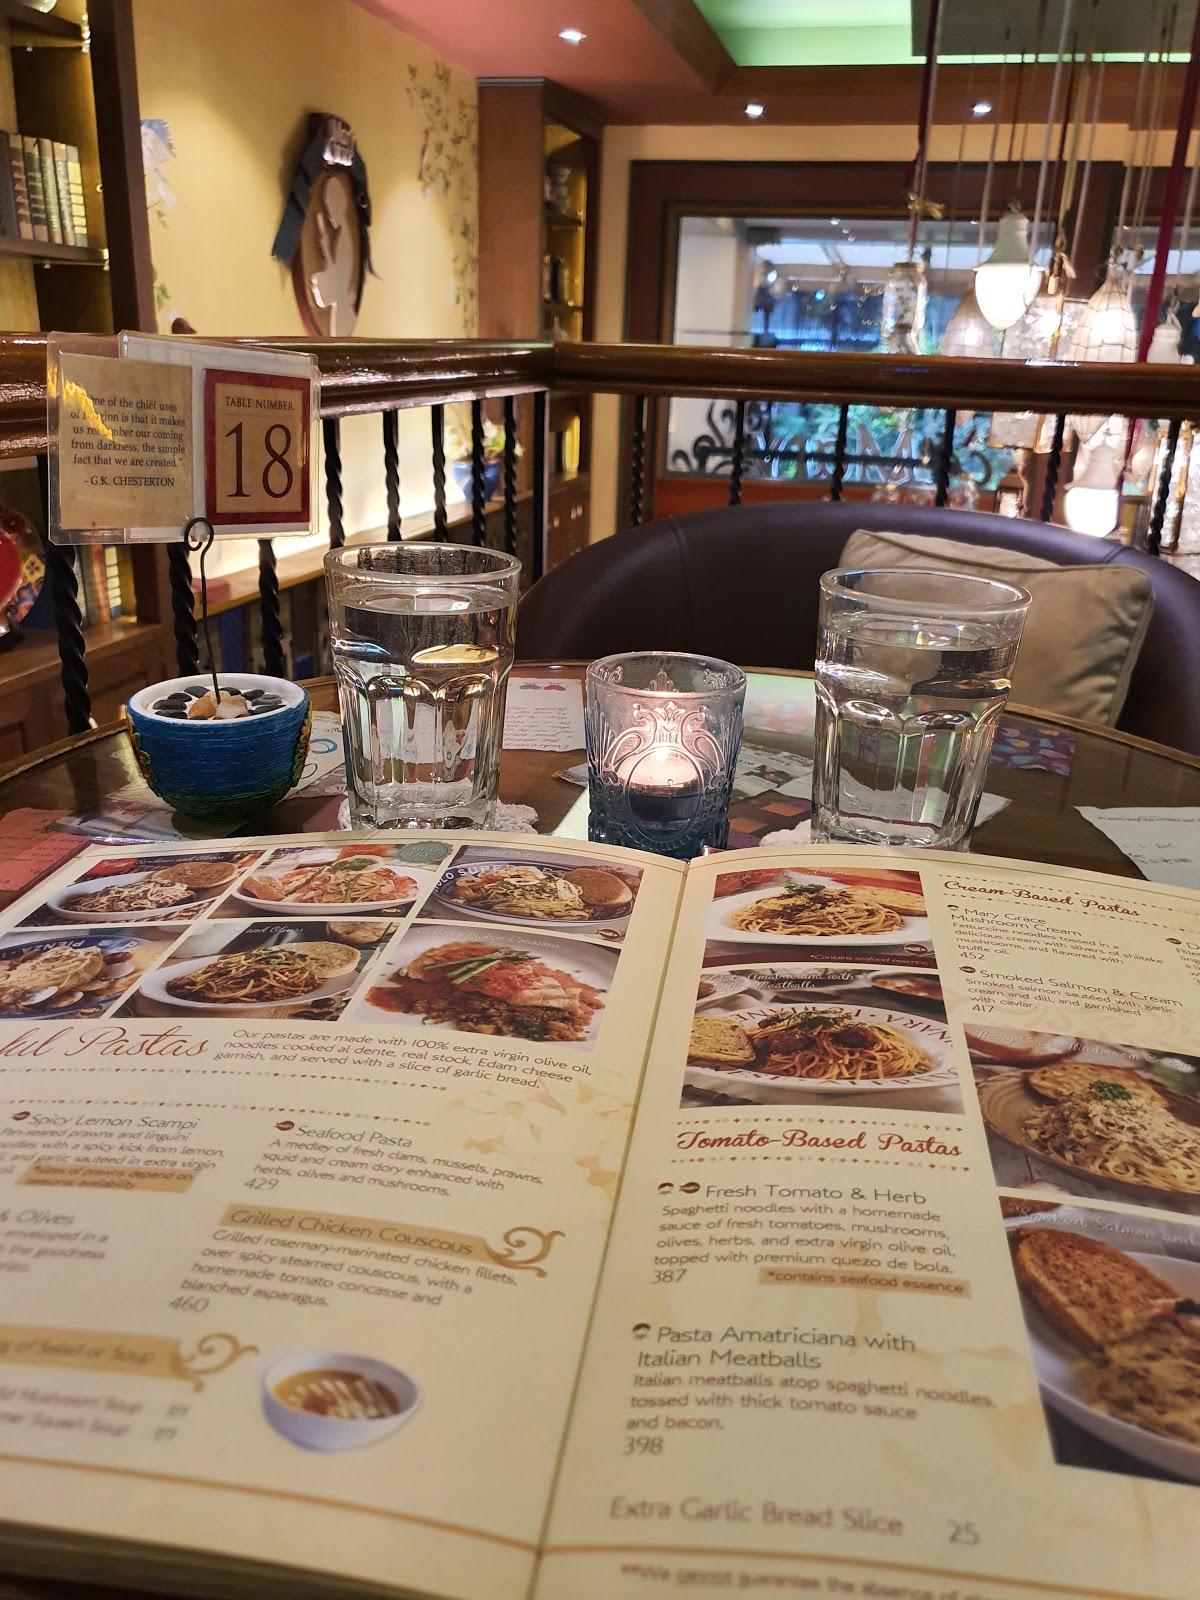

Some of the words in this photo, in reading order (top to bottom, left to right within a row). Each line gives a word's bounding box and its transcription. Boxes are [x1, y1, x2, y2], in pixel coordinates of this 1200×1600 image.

[108, 396, 117, 406] of
[119, 397, 133, 408] the
[136, 399, 156, 410] chief
[225, 396, 252, 409] TABLE
[255, 399, 293, 411] NUMBER
[121, 415, 129, 423] is
[131, 414, 148, 424] that
[151, 415, 157, 425] it
[159, 416, 186, 427] makes
[73, 426, 84, 434] us
[135, 429, 151, 438] our
[153, 430, 184, 443] coming
[71, 438, 94, 450] from
[97, 440, 140, 453] darkness,
[142, 442, 155, 453] the
[158, 444, 185, 456] simple
[73, 454, 91, 465] fact
[94, 454, 113, 465] that
[114, 457, 127, 466] we
[130, 457, 145, 467] are
[225, 421, 294, 499] 18
[112, 475, 175, 487] CHESTERTON
[944, 880, 1074, 905] Cream-Based
[1079, 898, 1141, 916] Pastas
[951, 914, 1029, 930] Mushroom
[1033, 923, 1082, 937] Cream
[964, 908, 999, 919] Mary
[1004, 913, 1047, 925] Grace
[960, 951, 985, 961] 452
[965, 978, 1014, 989] Smoked
[1017, 985, 1061, 996] salmon
[1115, 999, 1141, 1008] with
[979, 969, 1043, 985] Smoked
[1048, 978, 1107, 994] Salmon
[1111, 988, 1124, 997] &
[1129, 991, 1184, 1008] Cream
[972, 1004, 995, 1013] 417
[64, 1025, 209, 1056] Pastas
[233, 1029, 260, 1039] Our
[262, 1032, 305, 1041] pastas
[334, 1034, 373, 1044] made
[377, 1035, 407, 1047] with
[411, 1039, 450, 1051] 100%
[452, 1044, 488, 1056] extra
[492, 1049, 530, 1063] virgin
[534, 1057, 568, 1070] olive
[223, 1040, 279, 1051] noodles
[282, 1042, 336, 1054] cooked
[337, 1045, 351, 1054] al
[353, 1046, 397, 1058] dente,
[401, 1051, 429, 1061] real
[478, 1057, 517, 1072] Edam
[522, 1066, 573, 1082] cheese
[270, 1053, 297, 1062] and
[300, 1055, 349, 1065] served
[352, 1057, 383, 1067] with
[398, 1060, 432, 1072] slice
[435, 1064, 453, 1075] of
[452, 1067, 492, 1080] garlic
[496, 1072, 541, 1089] bread.
[28, 1114, 68, 1126] Spicy
[75, 1114, 133, 1127] Lemon
[137, 1116, 201, 1131] Scampi
[295, 1125, 365, 1142] Seafood
[369, 1132, 413, 1149] Pasta
[676, 1128, 867, 1151] Tomato-Based
[877, 1132, 962, 1157] Pastas
[270, 1139, 281, 1148] A
[285, 1141, 331, 1153] medley
[335, 1144, 352, 1153] of
[352, 1145, 385, 1158] fresh
[261, 1150, 299, 1163] squid
[300, 1153, 326, 1165] and
[328, 1158, 369, 1170] cream
[371, 1162, 403, 1175] dory
[406, 1167, 473, 1185] enhanced
[475, 1176, 505, 1191] with
[244, 1177, 280, 1191] 429
[705, 1184, 757, 1200] Fresh
[765, 1183, 843, 1200] Tomato
[849, 1187, 866, 1201] &
[874, 1188, 927, 1205] Herb
[661, 1202, 729, 1218] Spaghetti
[733, 1203, 794, 1214] noodles
[800, 1203, 834, 1215] with
[838, 1207, 847, 1216] a
[852, 1205, 941, 1222] homemade
[229, 1207, 295, 1229] Grilled
[297, 1215, 373, 1239] Chicken
[377, 1226, 474, 1257] Couscous
[658, 1222, 701, 1232] sauce
[706, 1218, 724, 1230] of
[727, 1217, 763, 1230] fresh
[761, 1235, 789, 1246] and
[794, 1236, 835, 1248] extra
[838, 1238, 883, 1252] virgin
[887, 1241, 928, 1255] olive
[931, 1244, 956, 1258] oil,
[654, 1251, 710, 1266] topped
[714, 1250, 748, 1263] with
[753, 1252, 826, 1266] premium
[830, 1256, 882, 1270] quezo
[886, 1257, 909, 1270] de
[912, 1258, 955, 1274] bola.
[650, 1268, 688, 1285] 387
[840, 1273, 897, 1289] seafood
[901, 1278, 965, 1294] essence
[169, 1296, 211, 1312] 460
[656, 1325, 713, 1344] Pasta
[719, 1325, 857, 1348] Amatriciana
[863, 1331, 917, 1352] with
[637, 1348, 702, 1367] Italian
[709, 1349, 822, 1370] Meatballs
[633, 1372, 682, 1388] Italian
[688, 1372, 774, 1389] meatballs
[779, 1375, 821, 1392] atop
[825, 1377, 909, 1398] spaghetti
[630, 1391, 690, 1409] tossed
[695, 1392, 733, 1408] with
[739, 1393, 783, 1409] thick
[788, 1396, 858, 1416] tomato
[862, 1403, 918, 1420] sauce
[626, 1413, 659, 1430] and
[622, 1435, 664, 1457] 398
[609, 1494, 671, 1521] Extra
[680, 1495, 752, 1523] Garlic
[760, 1499, 834, 1529] Bread
[842, 1506, 906, 1537] Slice
[946, 1517, 981, 1546] 25
